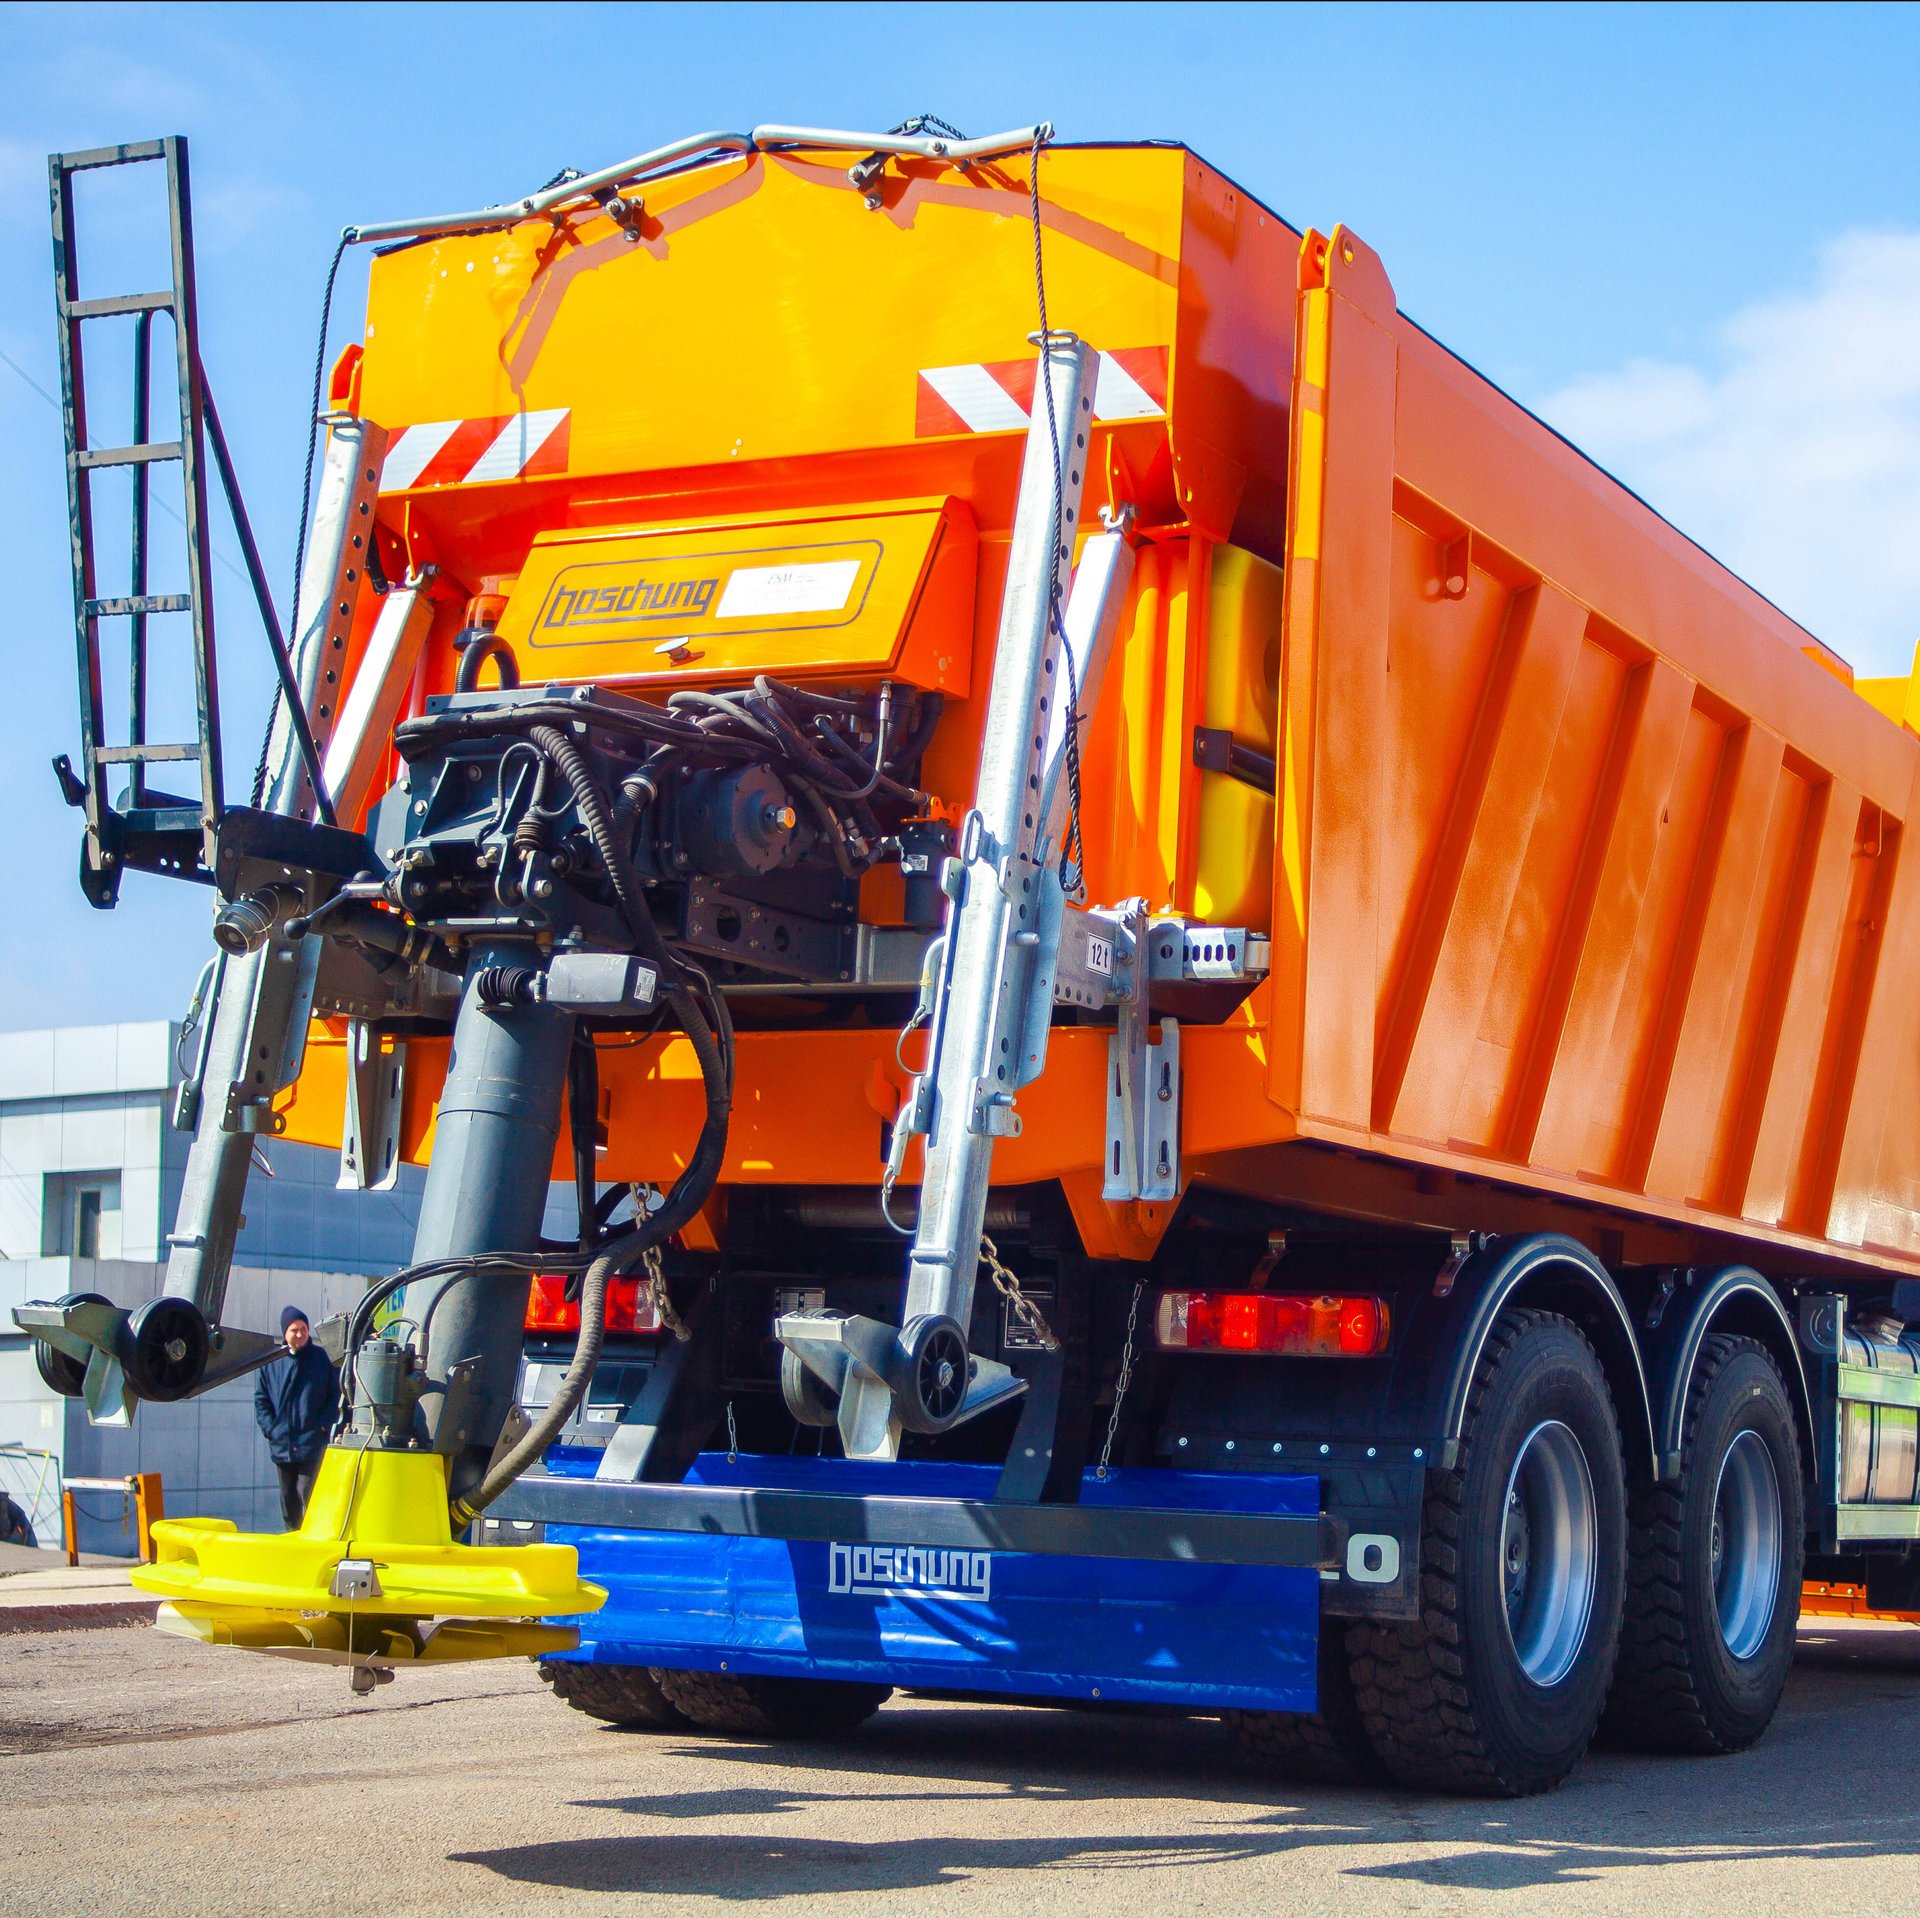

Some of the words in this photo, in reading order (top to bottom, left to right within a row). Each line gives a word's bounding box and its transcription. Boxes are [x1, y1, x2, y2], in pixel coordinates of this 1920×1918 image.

[543, 578, 720, 628] boschung
[1092, 942, 1102, 966] 12
[1104, 947, 1108, 968] t
[828, 1541, 991, 1602] boschung
